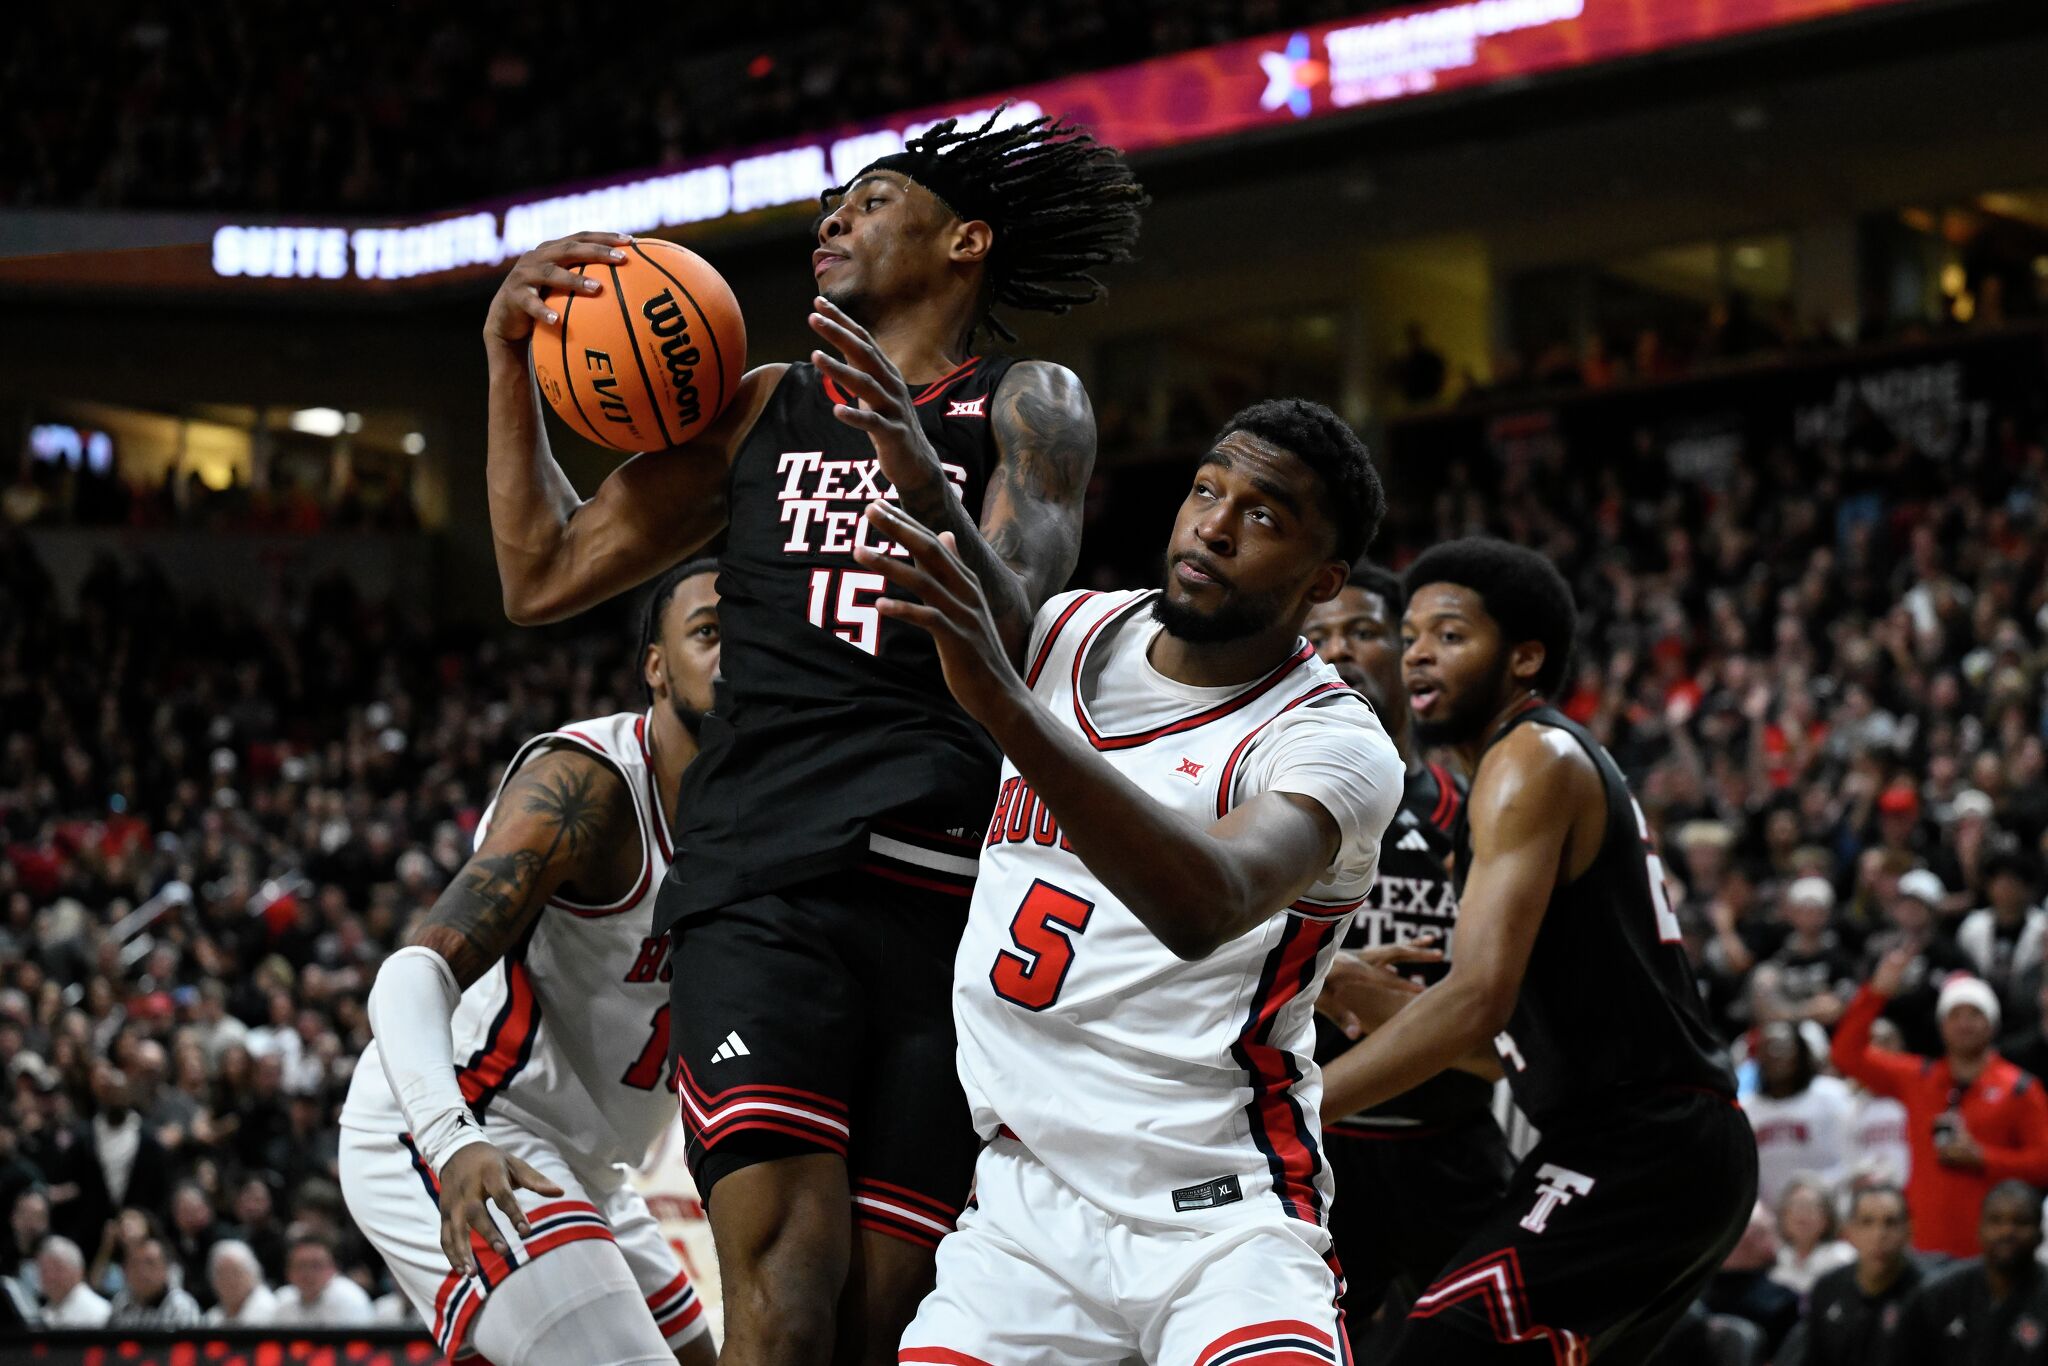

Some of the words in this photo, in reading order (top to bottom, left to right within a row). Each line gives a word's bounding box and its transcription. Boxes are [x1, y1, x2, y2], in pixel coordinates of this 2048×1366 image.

[213, 226, 348, 279] SUITE
[641, 287, 701, 431] Wilson
[776, 451, 968, 501] TEXS
[779, 500, 911, 557] TEC
[807, 568, 887, 657] 15
[989, 877, 1095, 1012] 5
[1218, 1184, 1232, 1197] XL
